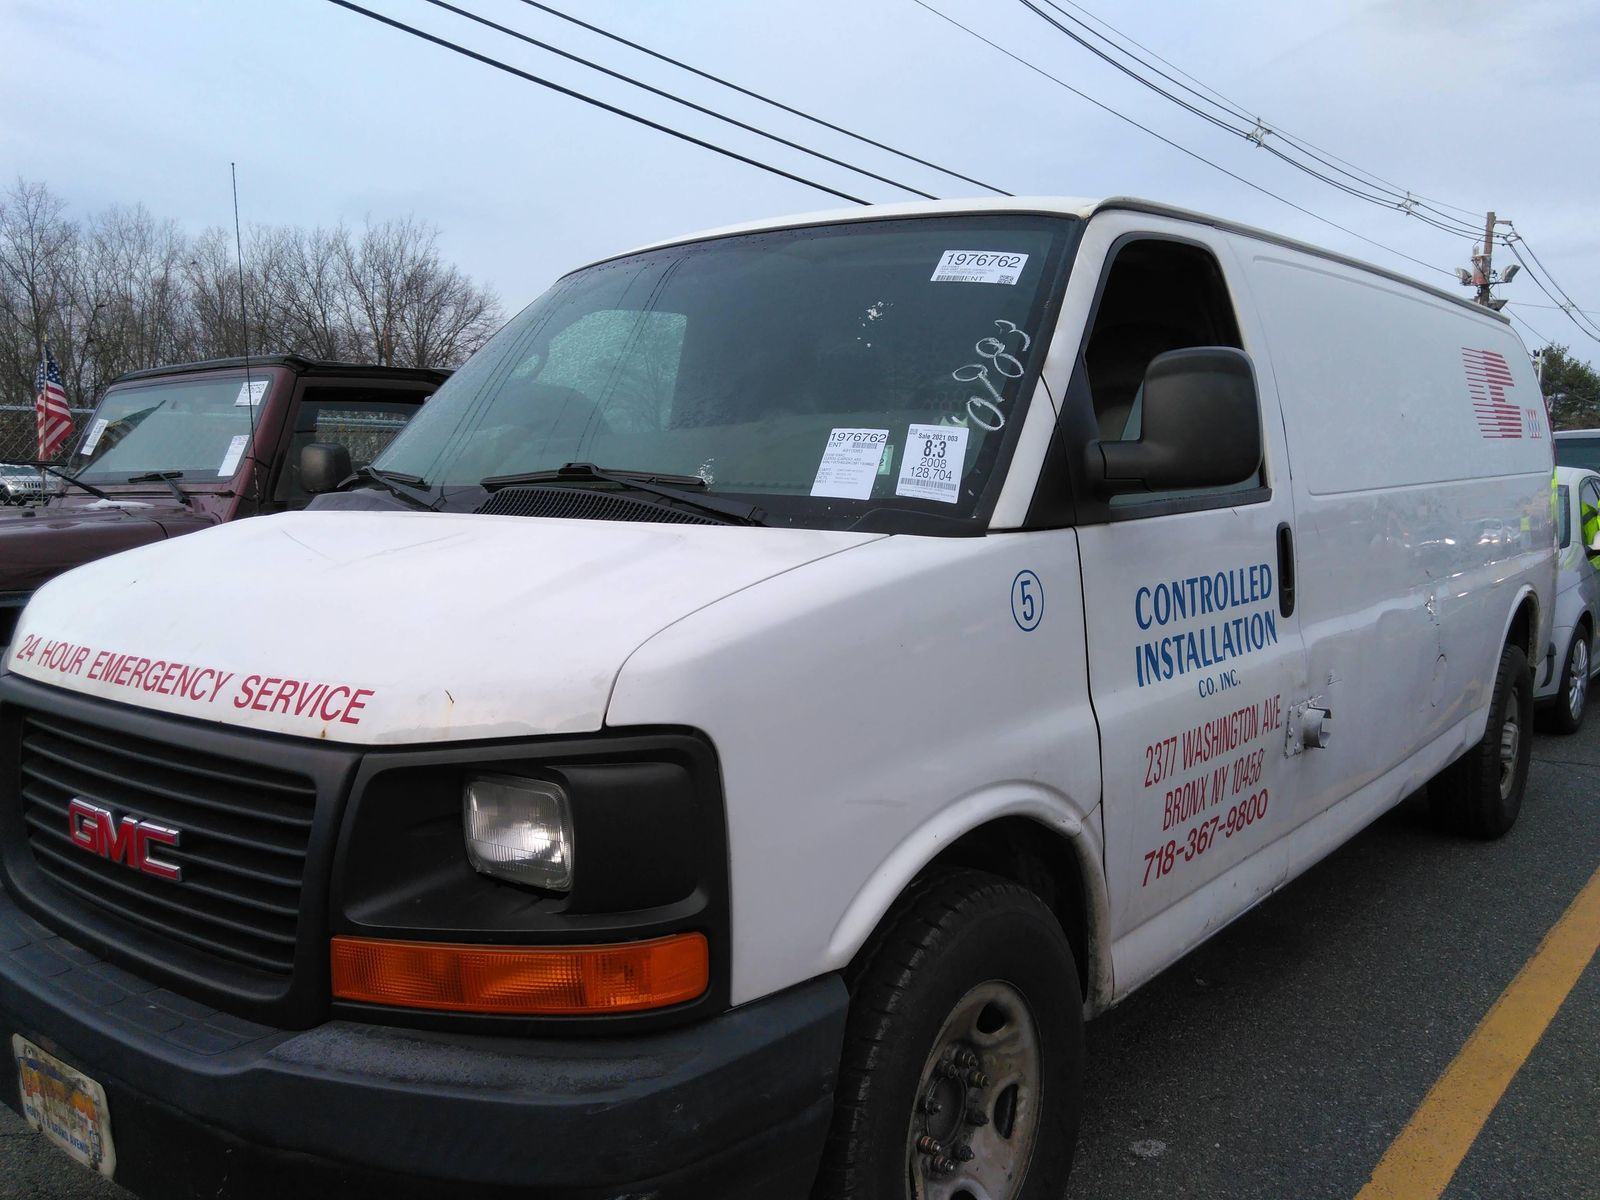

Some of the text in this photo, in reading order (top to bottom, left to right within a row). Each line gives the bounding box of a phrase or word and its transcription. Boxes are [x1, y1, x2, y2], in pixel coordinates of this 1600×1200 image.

[947, 253, 1021, 268] 1976762
[831, 432, 887, 443] 1976762
[918, 432, 931, 440] Sale
[932, 433, 946, 441] 2021
[923, 440, 947, 458] 8:3
[910, 466, 952, 481] 128,704
[920, 457, 947, 469] 2008
[1020, 579, 1034, 621] 5
[1135, 563, 1273, 631] CONTROLLED
[1135, 609, 1279, 688] INSTALLATION
[16, 633, 376, 725] 24 HOUR EMERGENCY SERVICE
[1198, 668, 1241, 698] CO. INC.
[1144, 735, 1178, 788] 2377
[1181, 703, 1260, 771] WASHINGTON
[1162, 748, 1265, 832] BRONX NY 10458
[68, 797, 182, 881] GMC
[1142, 788, 1269, 888] 718-367-9800
